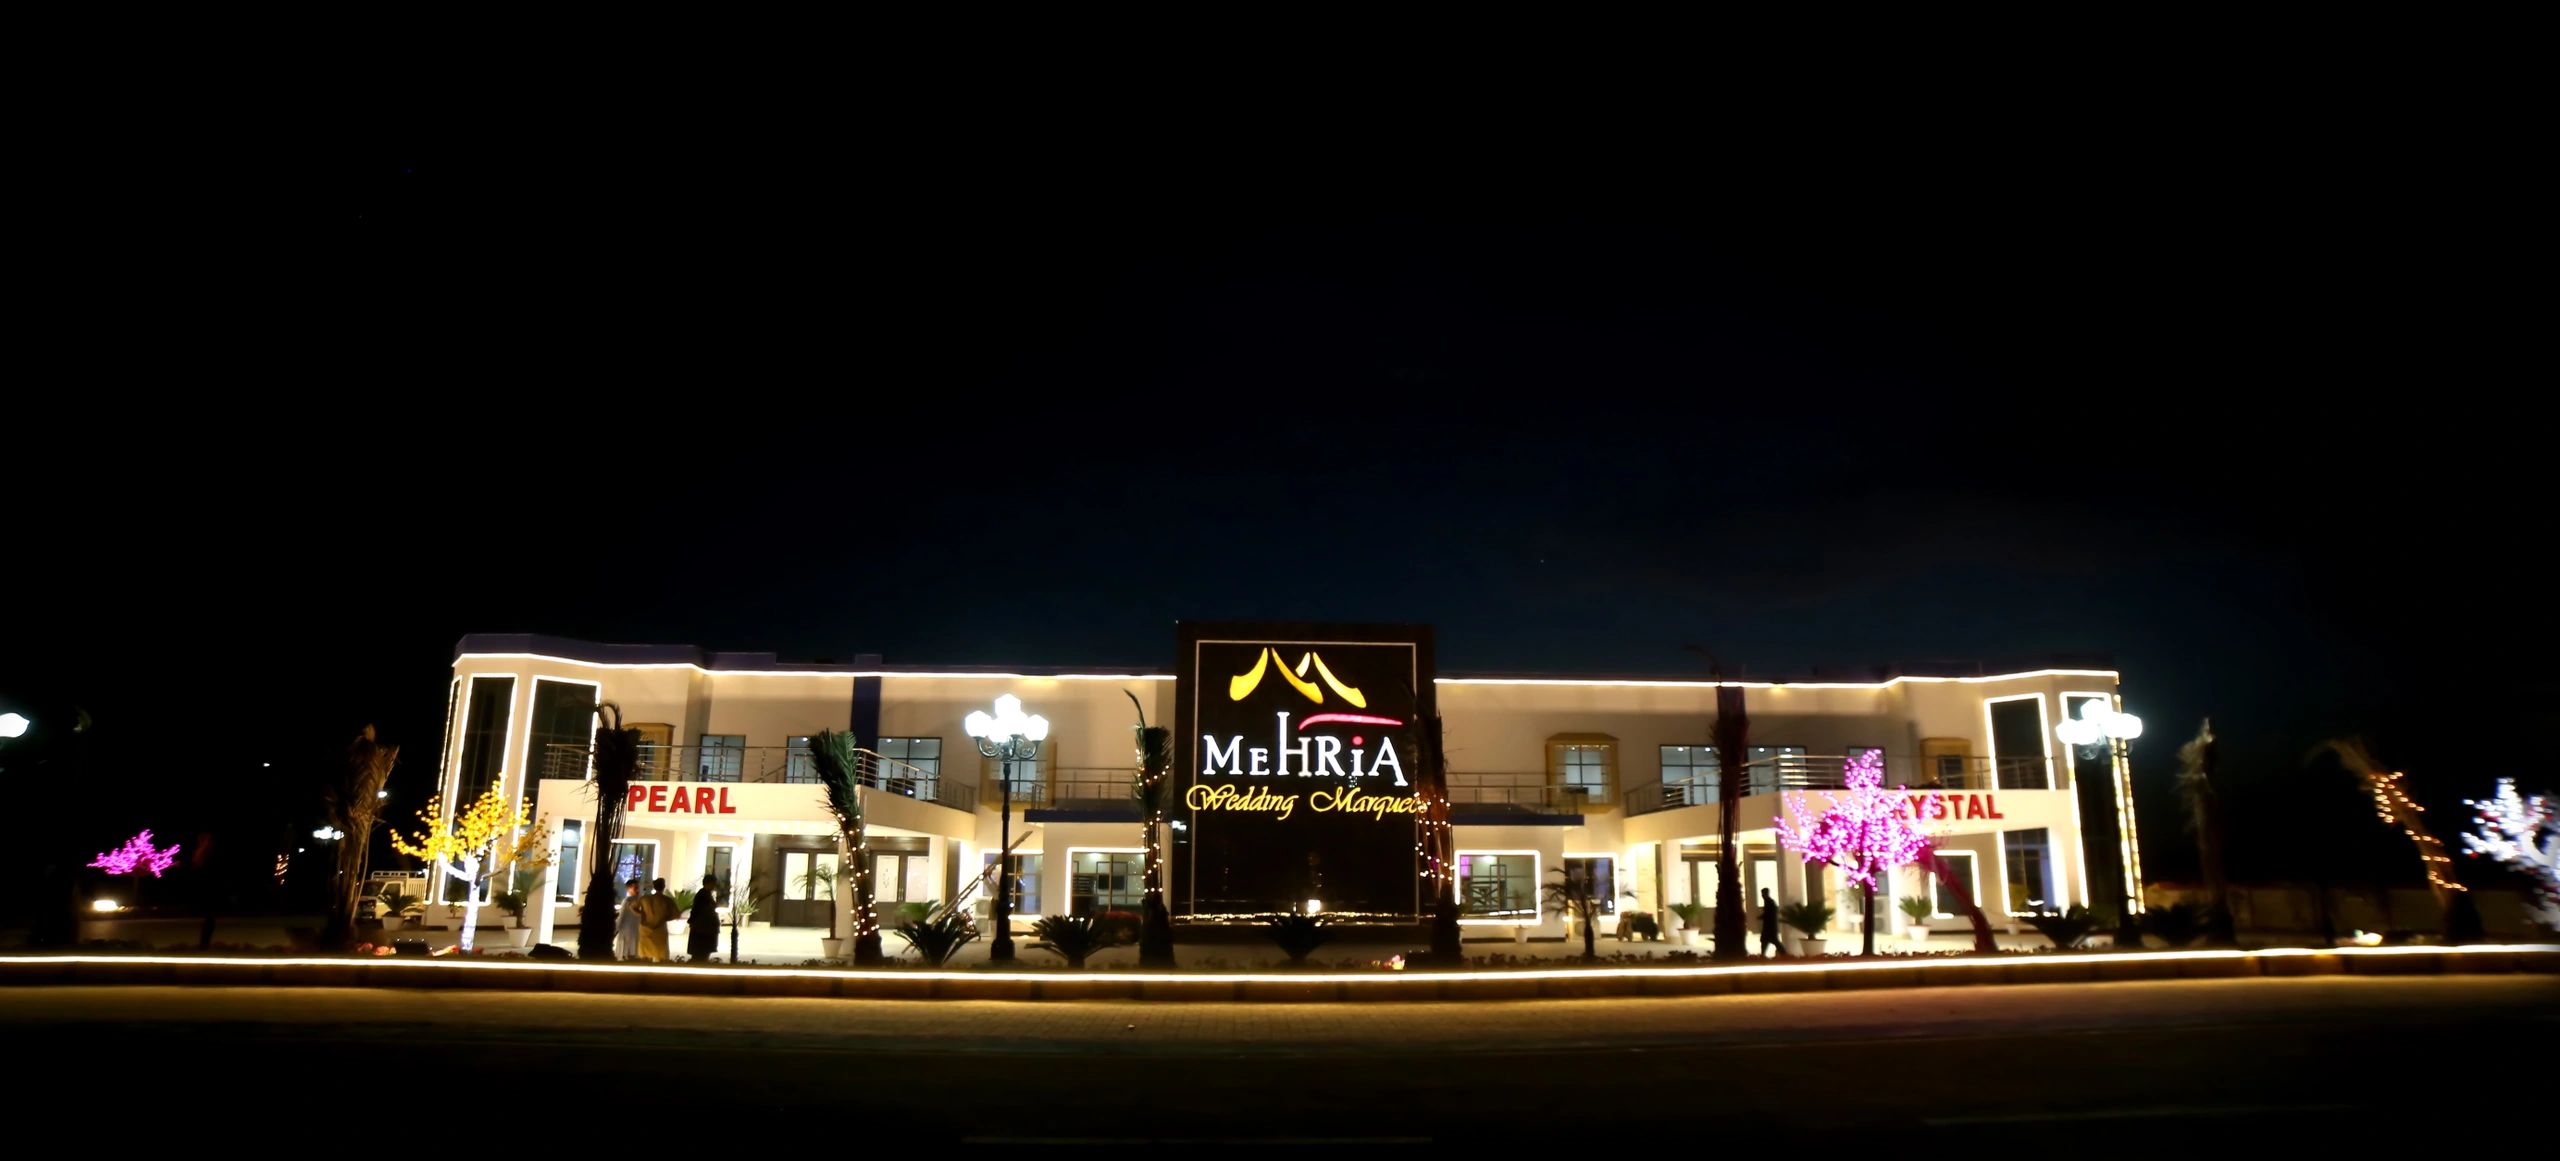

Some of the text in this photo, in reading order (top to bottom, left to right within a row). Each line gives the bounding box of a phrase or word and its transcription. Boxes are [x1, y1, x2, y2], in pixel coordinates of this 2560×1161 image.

[628, 785, 736, 814] PEARL
[1186, 784, 1299, 820] Wedding
[1888, 794, 2004, 820] YSTAL
